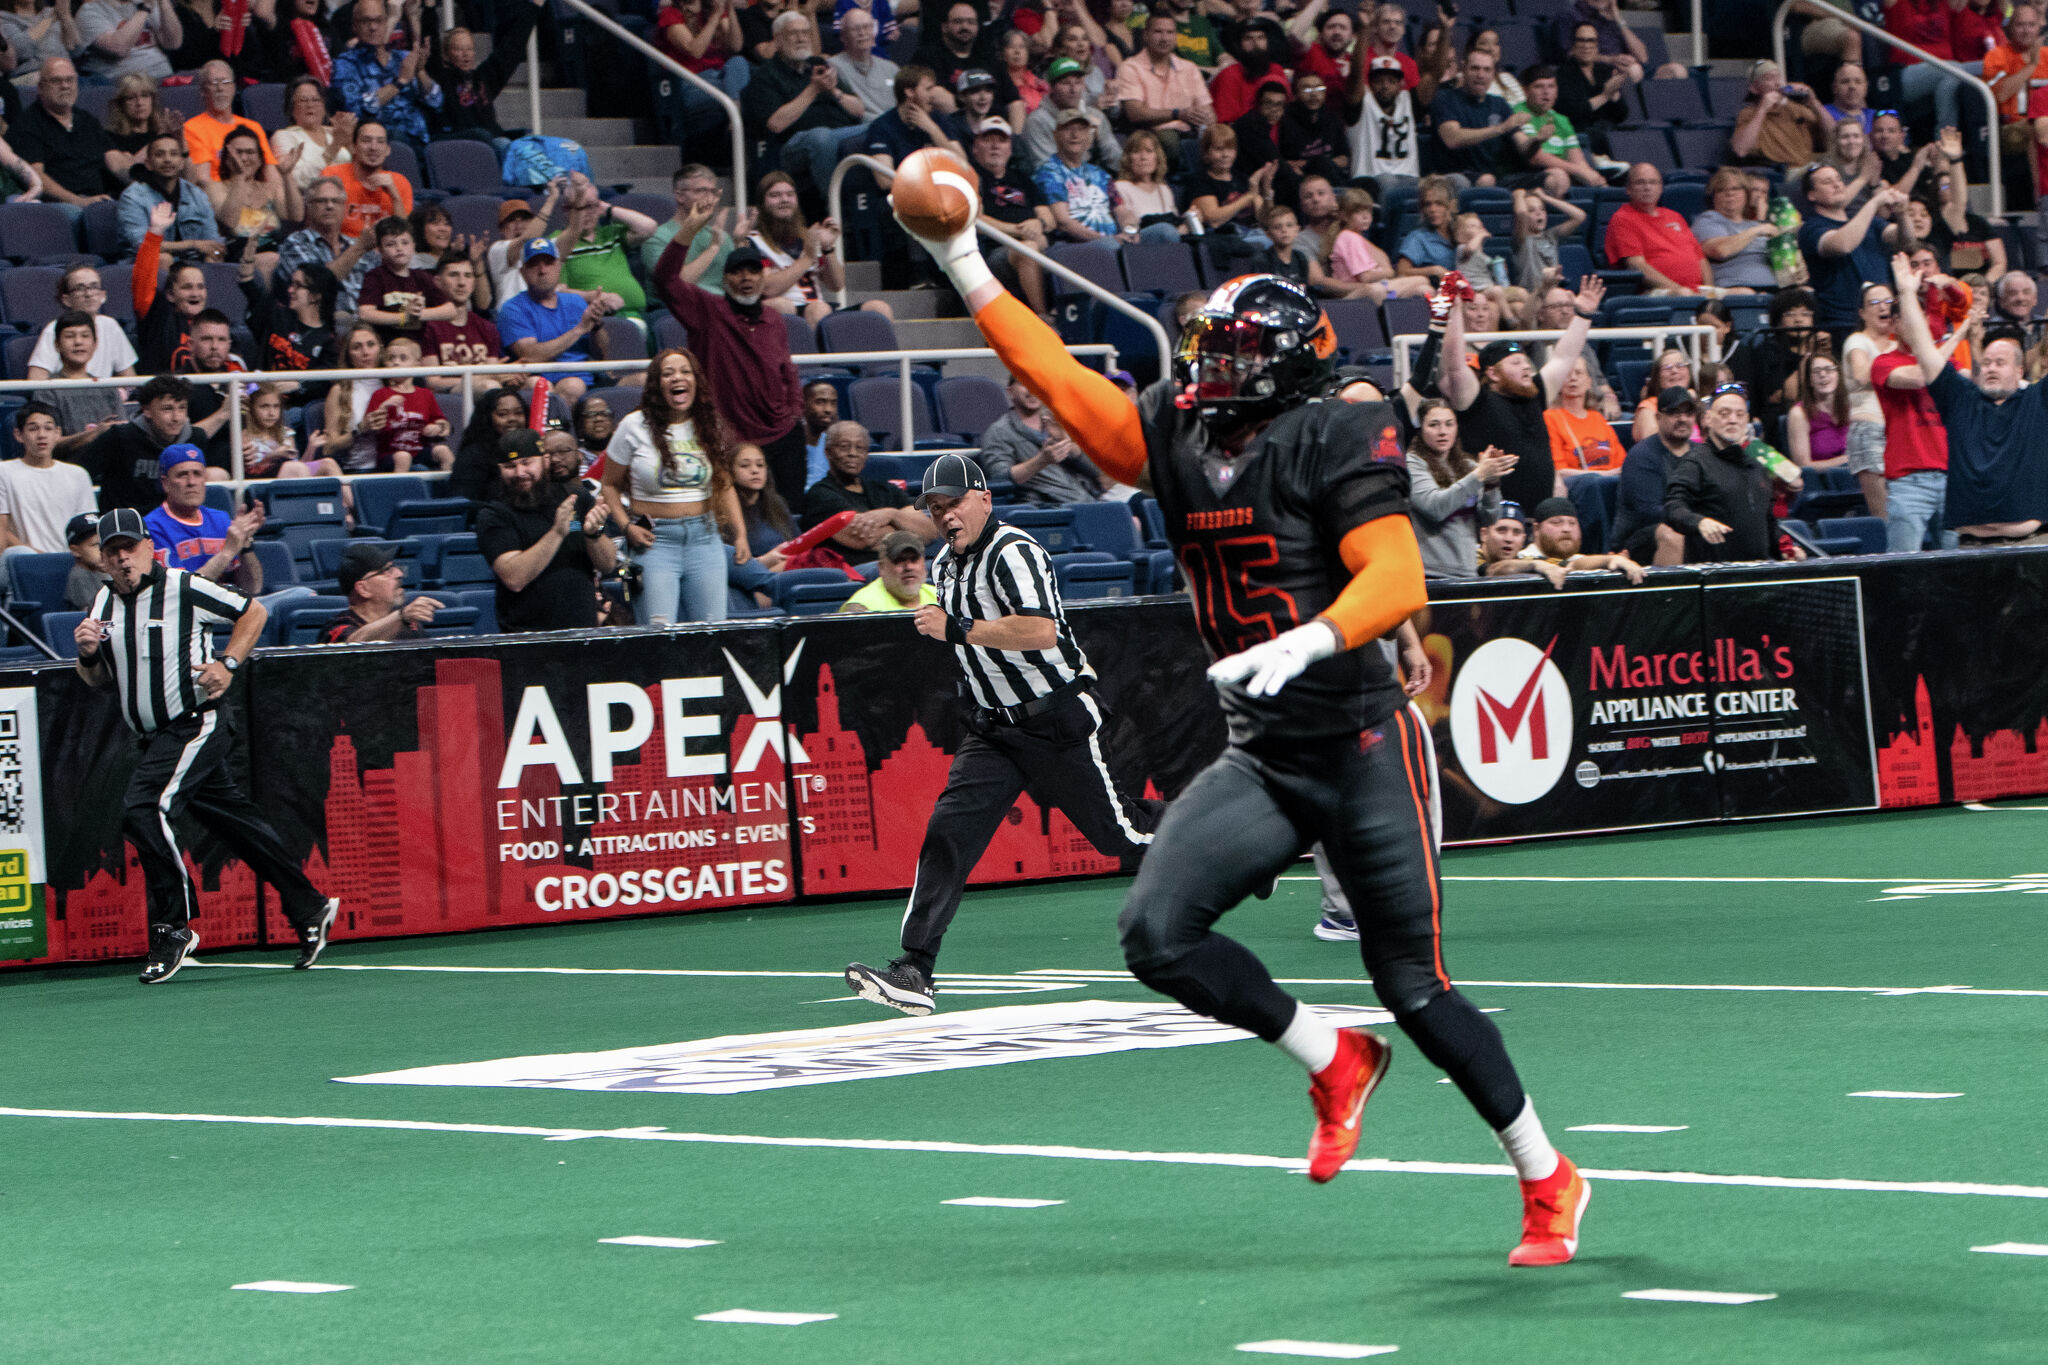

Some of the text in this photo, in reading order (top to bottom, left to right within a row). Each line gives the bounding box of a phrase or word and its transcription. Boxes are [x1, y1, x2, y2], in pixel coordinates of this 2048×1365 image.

[857, 193, 868, 210] E
[1066, 304, 1079, 322] C
[1186, 507, 1254, 530] FIREBIRDS
[1181, 534, 1300, 662] 15
[1588, 634, 1795, 692] Marcella's
[497, 637, 811, 789] APEX
[1590, 688, 1800, 726] APPLIANCE CENTER
[500, 840, 560, 862] FOOD
[578, 828, 718, 858] ATTRACTIONS
[0, 856, 20, 876] rd
[535, 859, 788, 913] CROSSGATES
